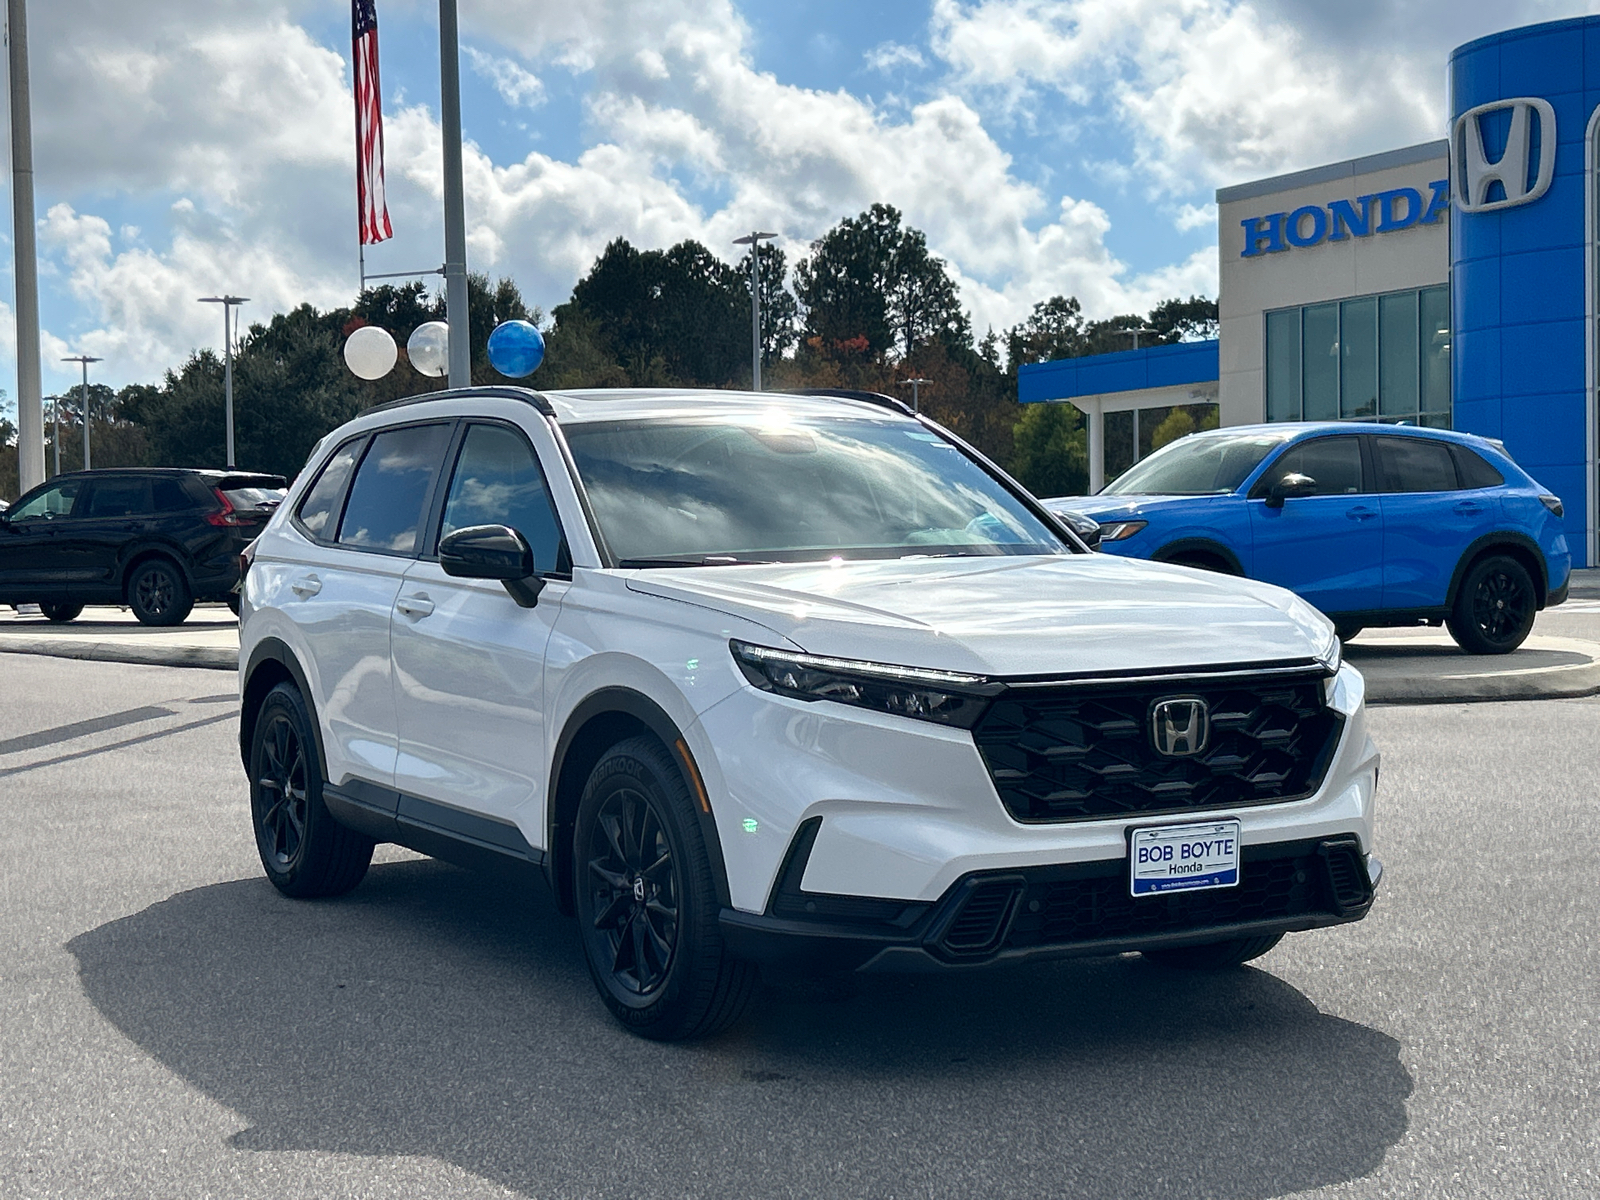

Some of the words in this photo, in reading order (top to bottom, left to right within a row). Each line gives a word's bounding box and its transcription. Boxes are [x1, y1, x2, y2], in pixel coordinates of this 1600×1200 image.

[1139, 846, 1173, 863] BOB
[1181, 839, 1234, 859] BOYTE
[1169, 862, 1203, 875] Honda
